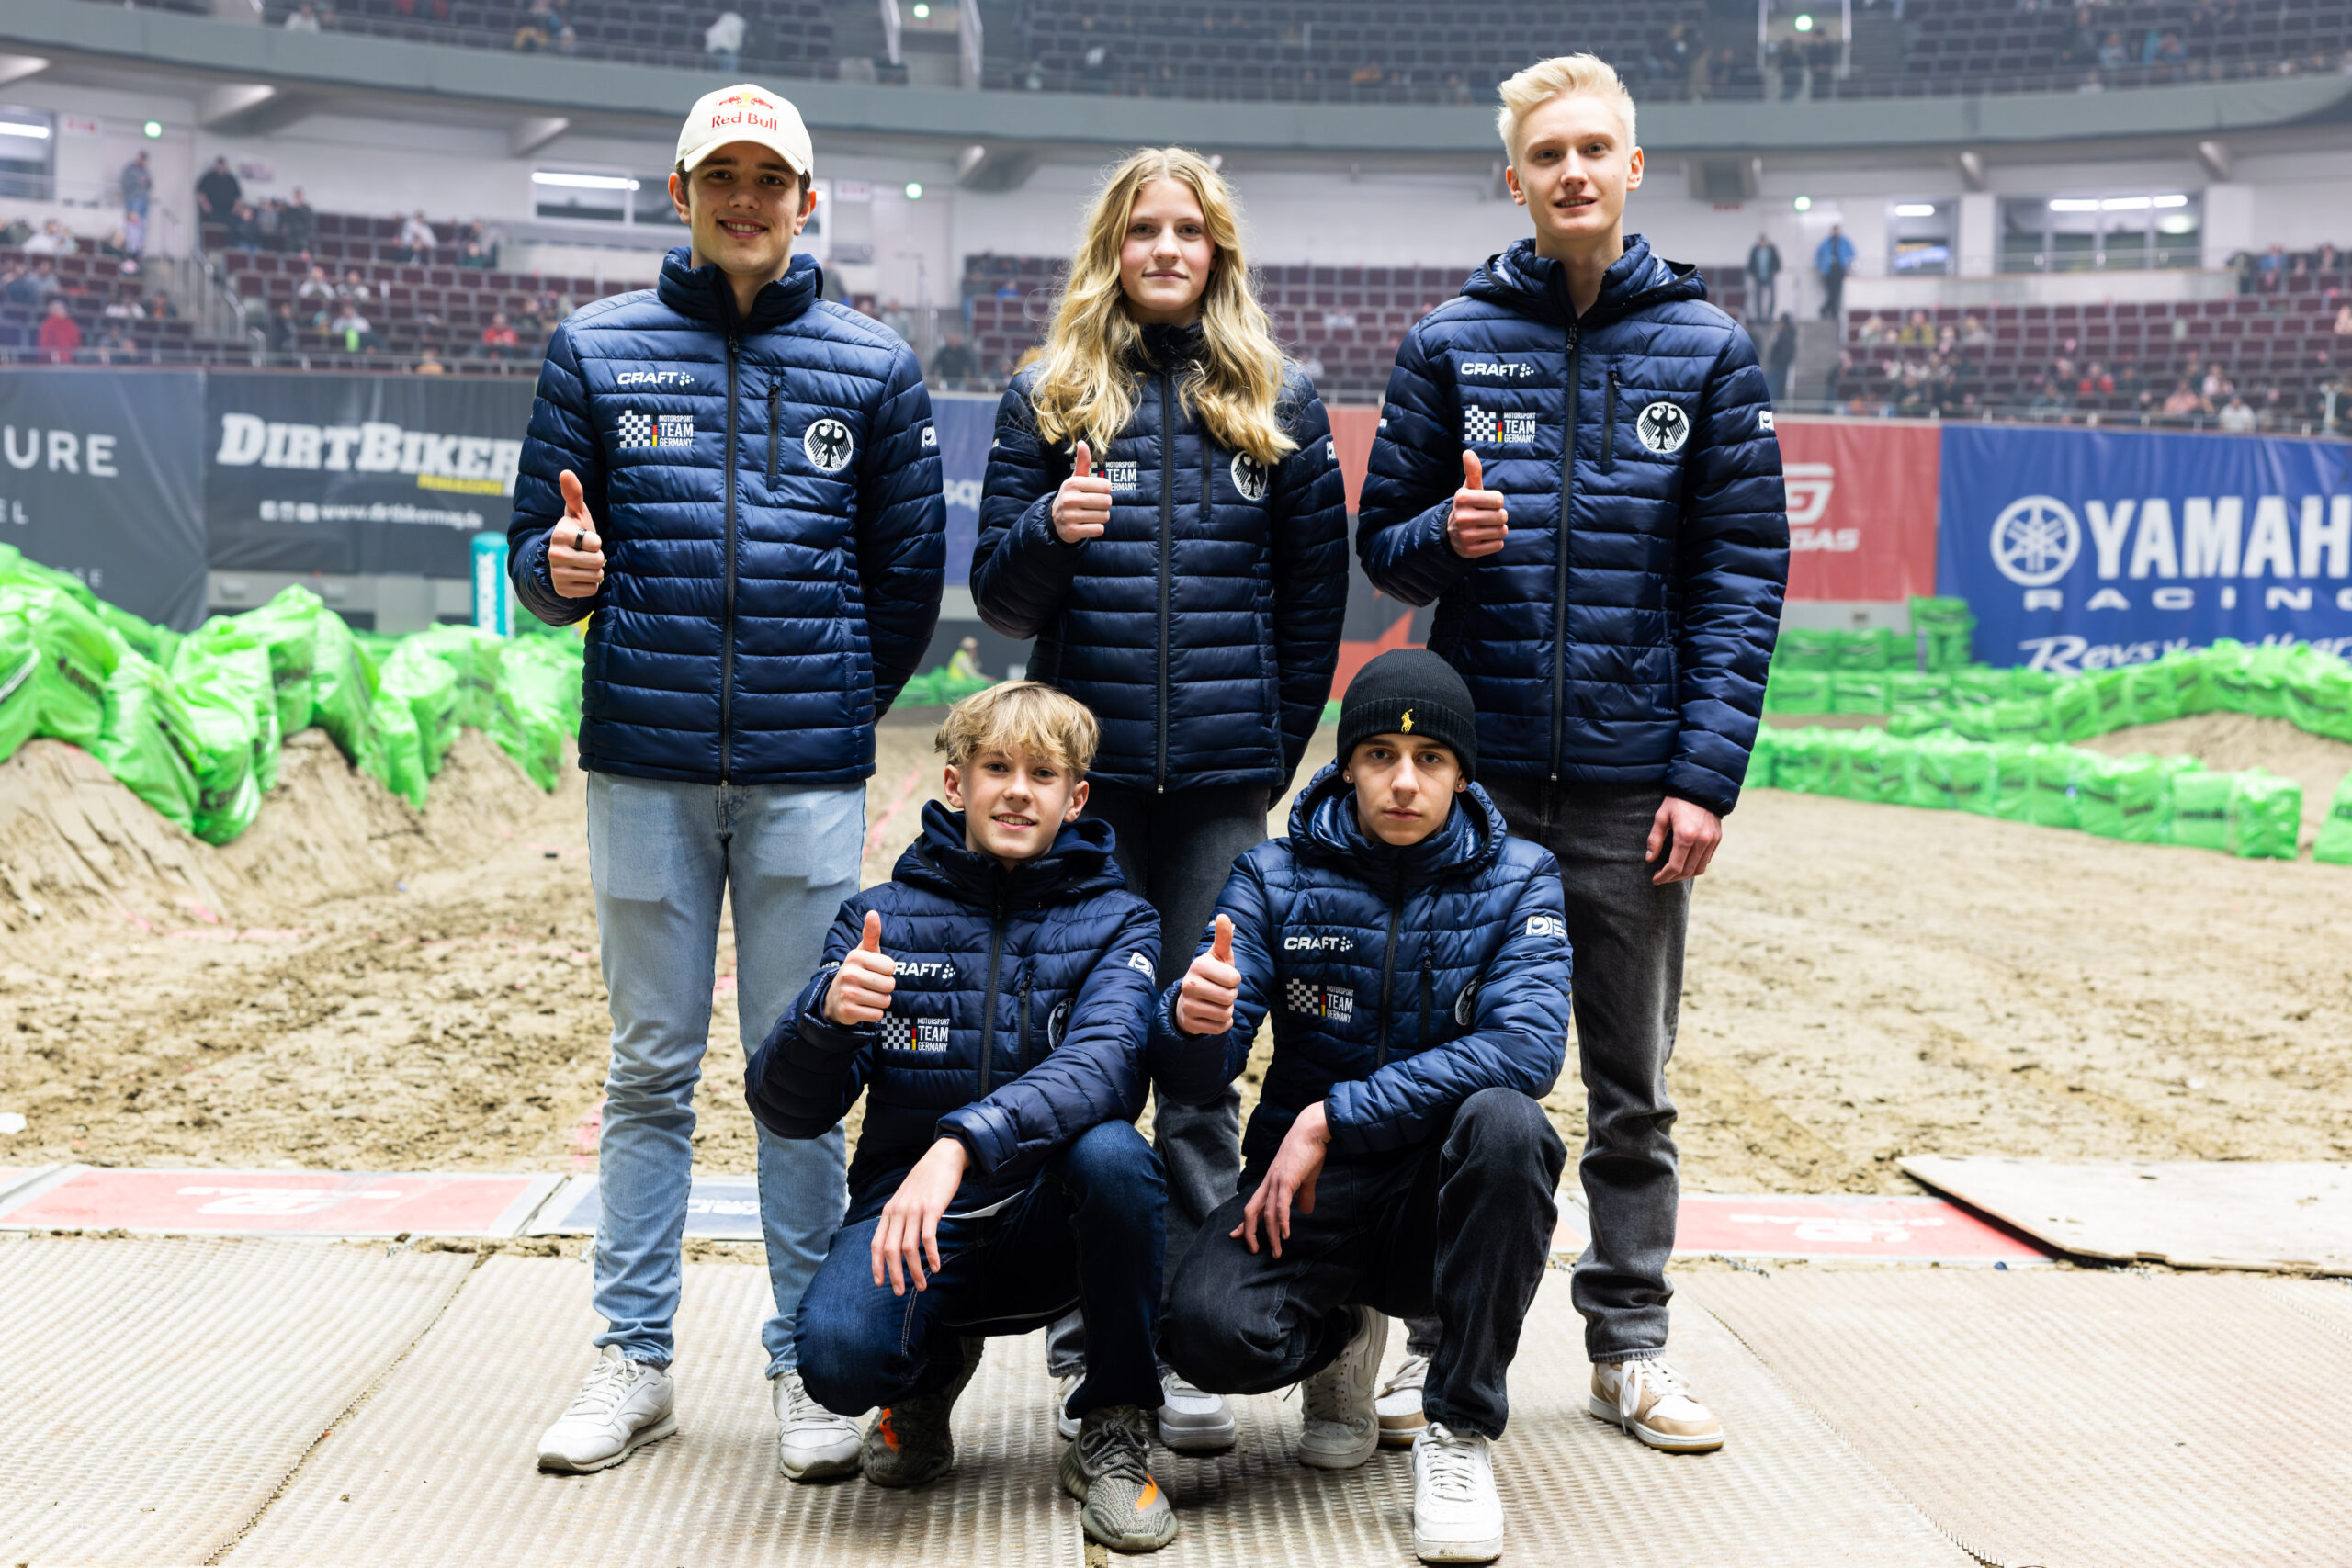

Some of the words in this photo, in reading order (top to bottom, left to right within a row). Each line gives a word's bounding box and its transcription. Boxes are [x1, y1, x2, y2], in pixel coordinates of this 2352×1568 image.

[712, 111, 741, 128] Red
[748, 112, 777, 131] Bull
[1461, 363, 1519, 377] CRAFT
[617, 371, 679, 385] CRAFT
[658, 414, 694, 423] MOTORSPORT
[1503, 412, 1536, 420] MOTORSPORT
[659, 423, 694, 437] TEAM
[1504, 420, 1536, 434] TEAM
[659, 437, 694, 447] GERMANY
[1503, 434, 1535, 443] GERMANY
[4, 424, 119, 478] URE
[1106, 468, 1137, 482] TEAM
[1110, 482, 1137, 491] ERMANY
[2085, 495, 2352, 579] YAMAH
[1283, 936, 1339, 950] CRAFT
[893, 961, 942, 976] RAFT
[1326, 985, 1354, 997] MOTORSPORT
[1327, 993, 1353, 1013] TEAM
[917, 1017, 950, 1025] MOTORSPORT
[1326, 1008, 1351, 1023] GERMANY
[918, 1025, 949, 1042] TEAM
[917, 1041, 947, 1052] GERMANY
